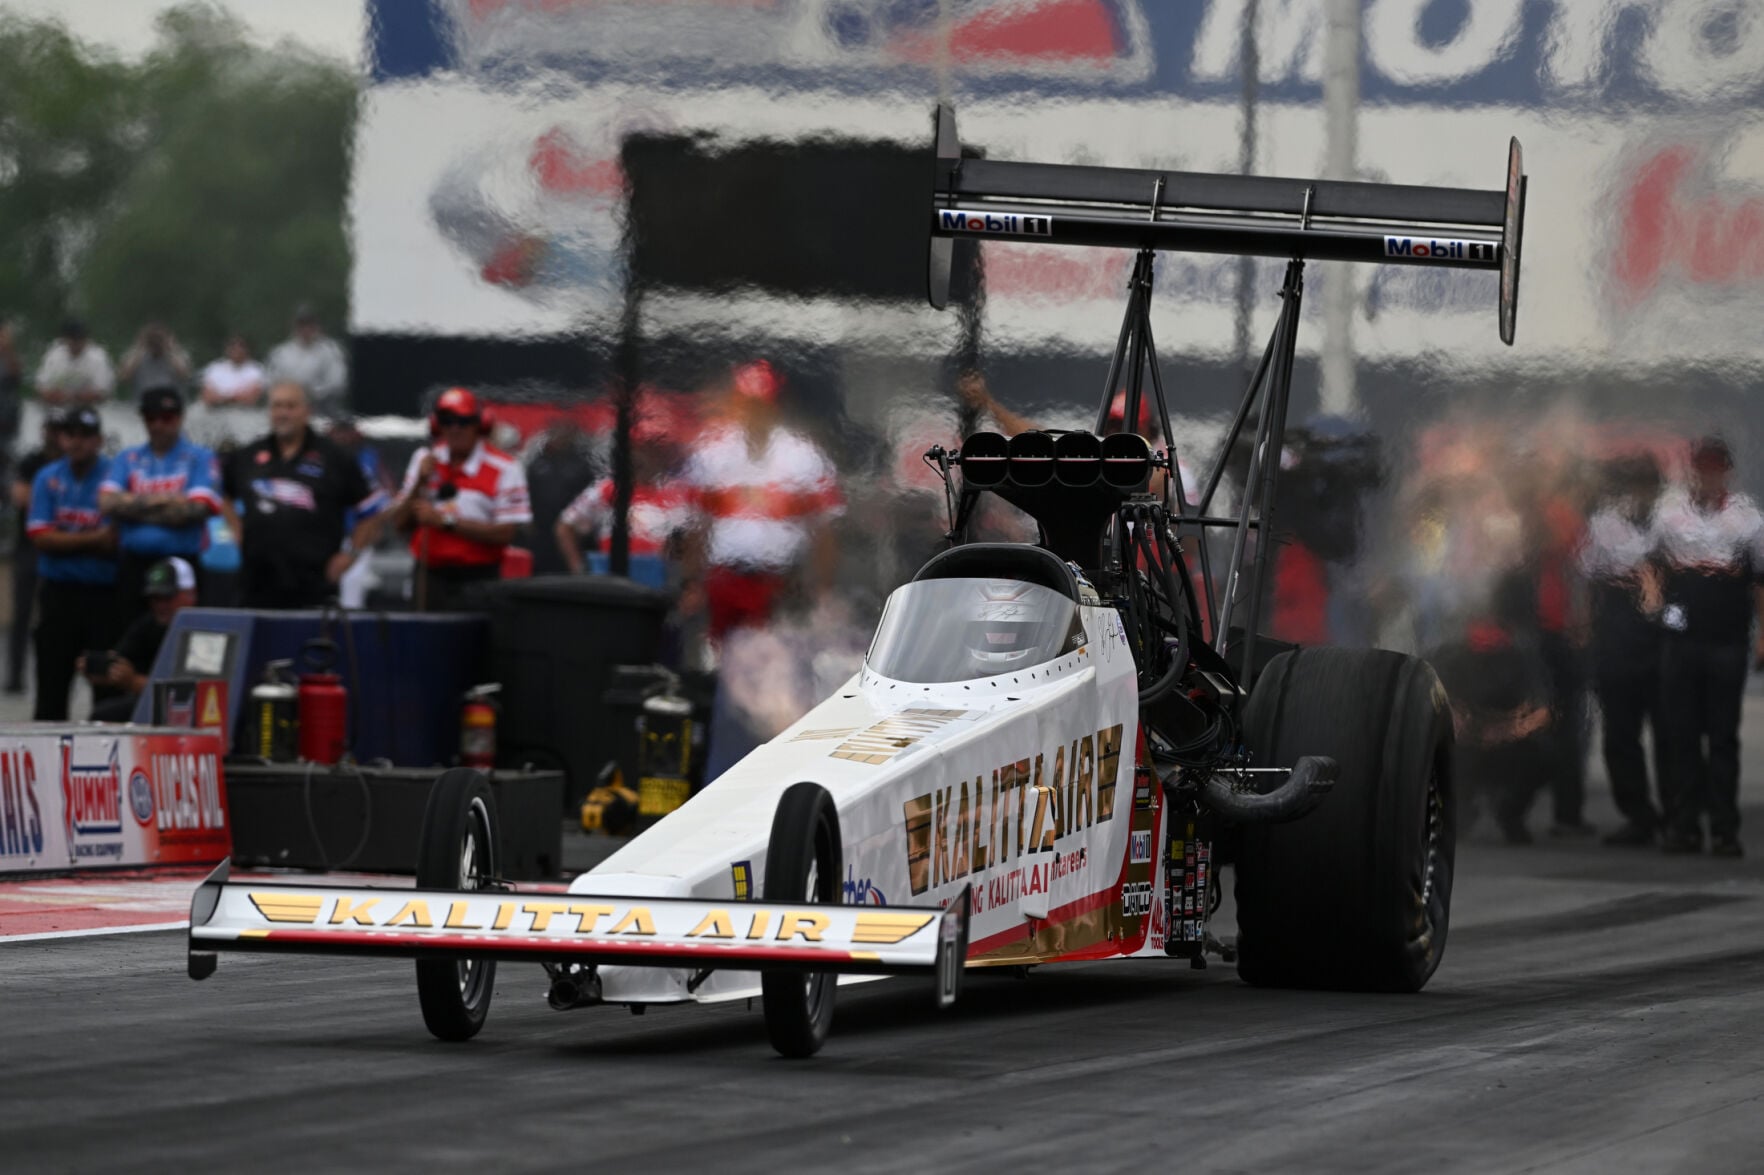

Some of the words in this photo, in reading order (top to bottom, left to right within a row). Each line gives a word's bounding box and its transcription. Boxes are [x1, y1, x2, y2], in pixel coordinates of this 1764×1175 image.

[942, 211, 1017, 233] Mobil
[1387, 238, 1463, 259] Mobil
[0, 751, 43, 855] ALS
[152, 753, 199, 830] LUCAS
[199, 753, 224, 830] OIL
[933, 753, 1055, 889] KALITTA
[327, 895, 657, 936] KALITTA
[685, 909, 831, 942] AIR
[1151, 936, 1164, 950] TOOLS
